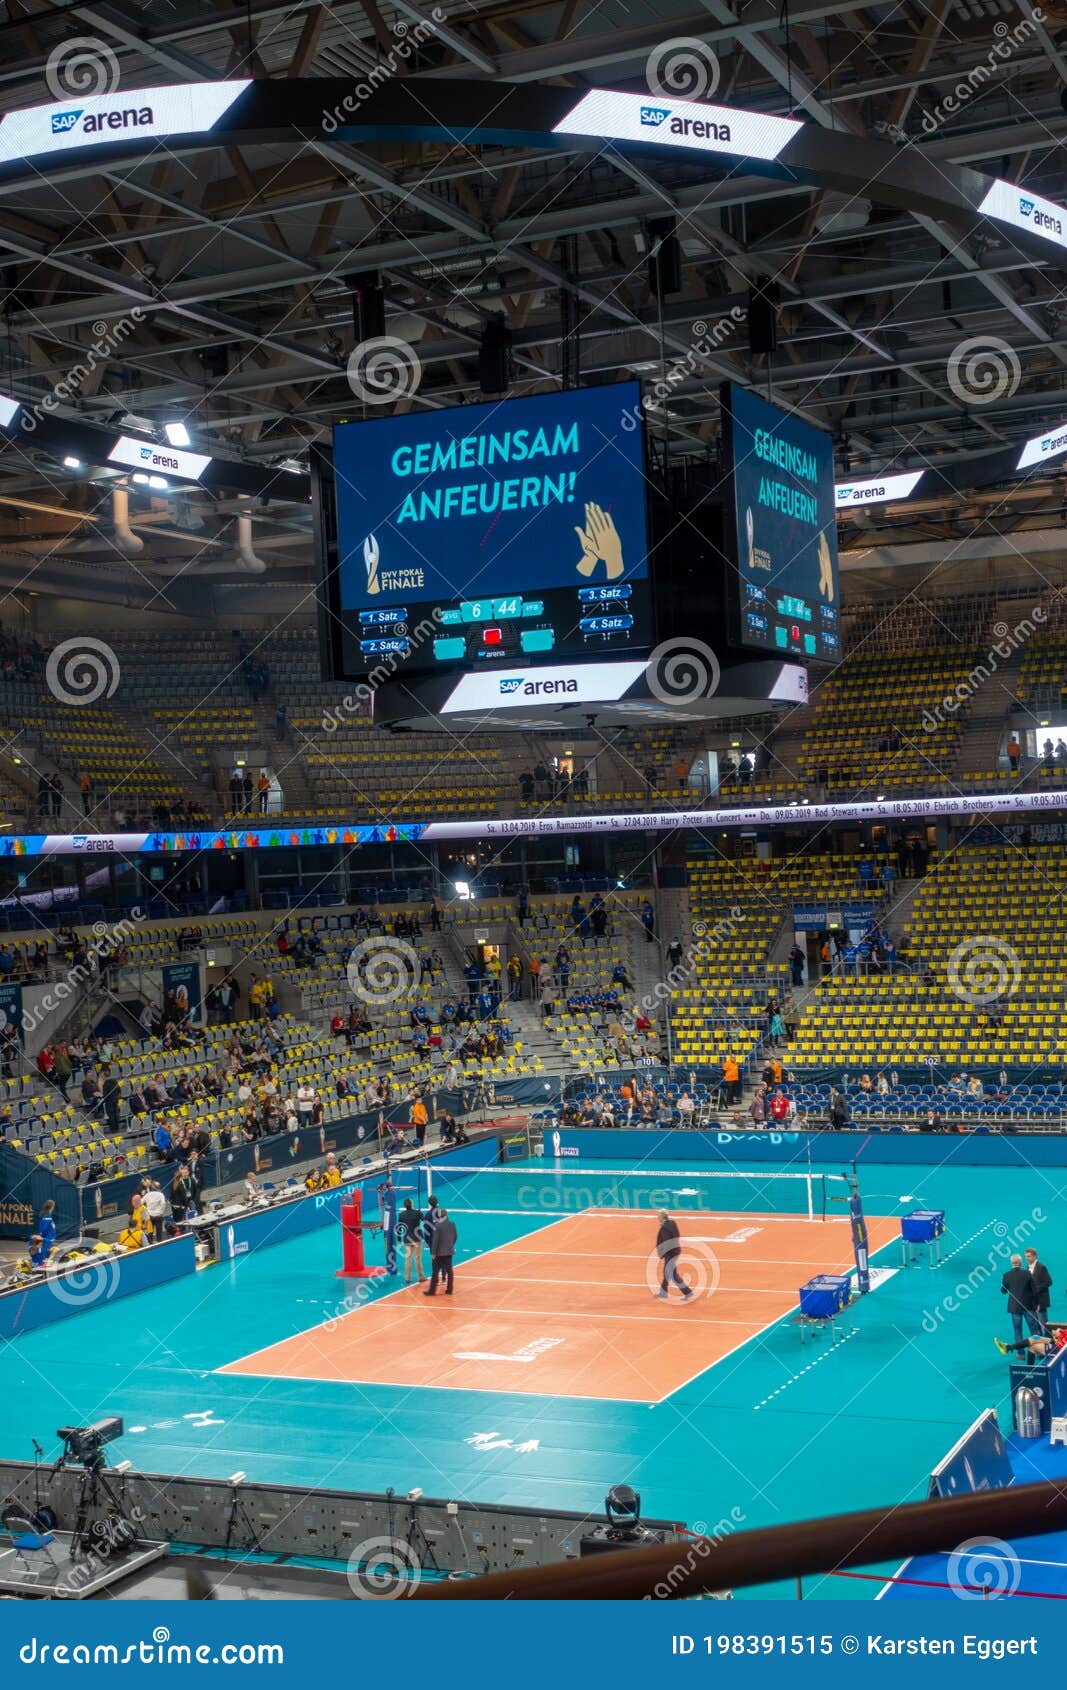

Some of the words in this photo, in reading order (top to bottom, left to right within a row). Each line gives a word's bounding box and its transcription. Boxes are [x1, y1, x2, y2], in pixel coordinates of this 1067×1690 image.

[51, 112, 79, 132] SAP
[83, 107, 154, 133] arena
[640, 108, 667, 125] SAP
[670, 117, 731, 142] arena
[1034, 210, 1062, 235] arena
[391, 422, 579, 477] GEMEINSAM
[754, 428, 818, 483] GEMEINSAM
[152, 454, 178, 469] arena
[396, 471, 577, 524] ANFEUERN!
[758, 476, 818, 526] ANFEUERN!
[853, 486, 885, 500] arena
[381, 570, 397, 579] DVV
[398, 567, 424, 577] POKAL
[381, 576, 425, 591] FINALE
[588, 590, 597, 600] 3.
[599, 587, 621, 599] Satz
[368, 613, 376, 622] 1.
[377, 611, 398, 622] Satz
[472, 603, 481, 617] 6
[498, 600, 517, 614] 44
[589, 620, 598, 629] 4.
[600, 617, 623, 629] Satz
[370, 642, 377, 651] 2.
[378, 639, 400, 650] Satz
[500, 679, 521, 693] SAP
[524, 677, 578, 696] arena
[501, 821, 536, 832] 13.04.2019
[540, 821, 553, 831] Eros
[556, 819, 593, 830] Ramazzotti
[660, 815, 679, 827] Harry
[682, 815, 702, 824] Potter
[706, 814, 713, 823] in
[716, 813, 741, 822] Concert
[775, 808, 811, 819] 09.05.2019
[815, 807, 828, 817] Rod
[831, 806, 858, 816] Stewart
[893, 802, 930, 813] 18.05.2019
[934, 800, 958, 811] Ehrlich
[963, 799, 994, 810] Brothers
[87, 839, 114, 851] arena
[642, 1058, 655, 1066] 101
[923, 1057, 938, 1066] 102
[517, 1177, 711, 1211] comdirect
